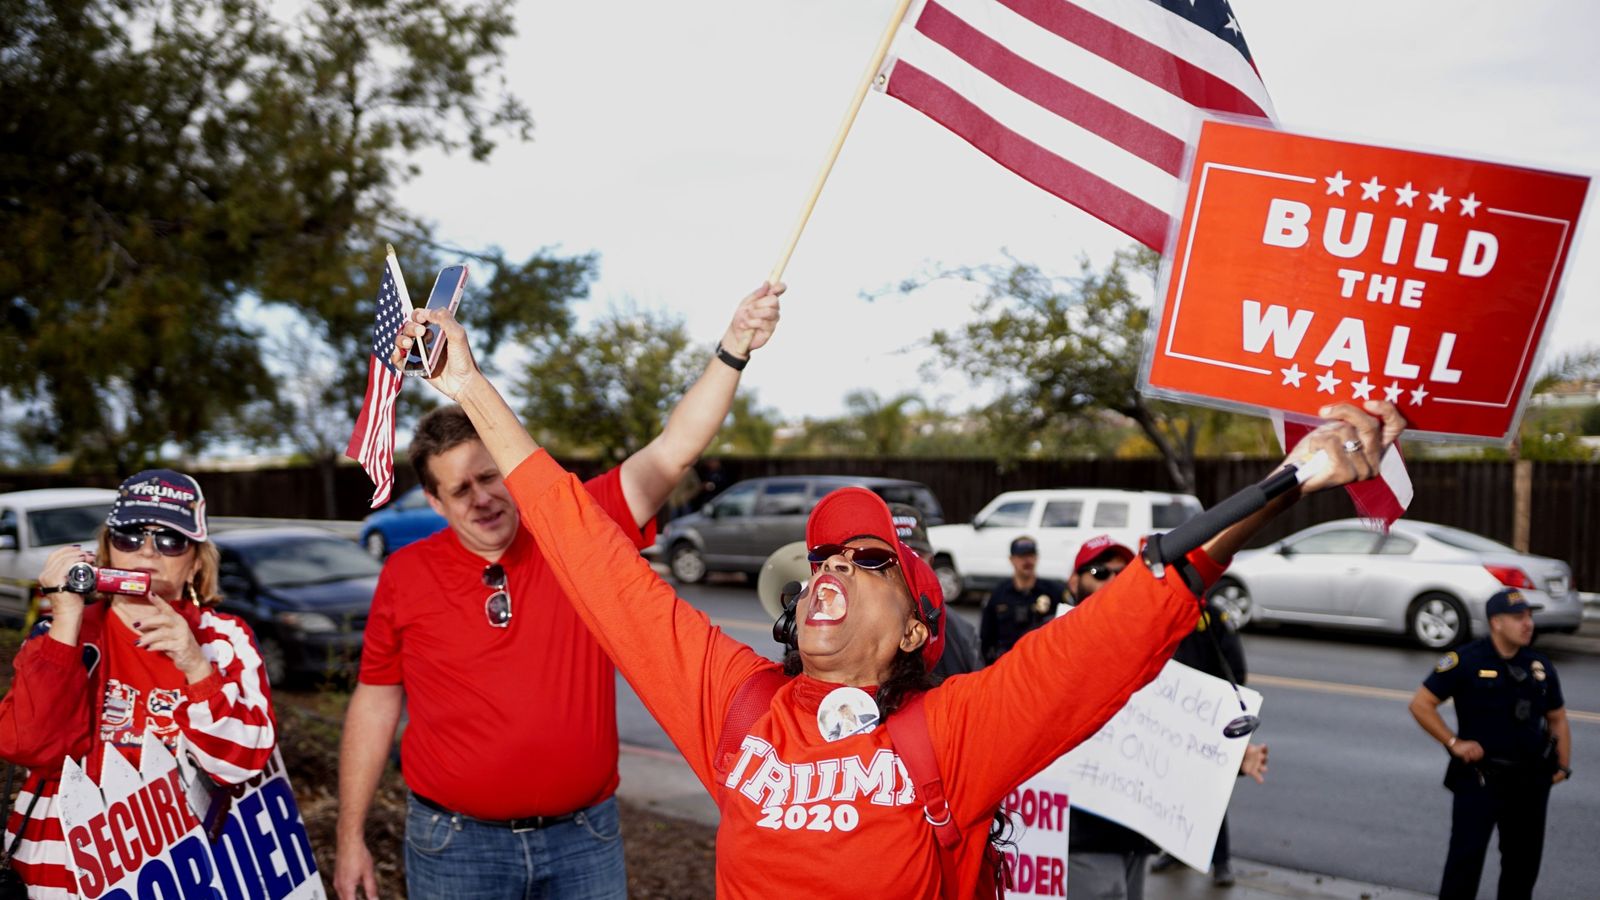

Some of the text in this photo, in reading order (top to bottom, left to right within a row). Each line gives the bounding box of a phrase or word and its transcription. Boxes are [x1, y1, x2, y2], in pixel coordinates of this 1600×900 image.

[1262, 198, 1500, 278] BUILD
[1337, 268, 1427, 309] THE
[1242, 299, 1463, 384] WALL
[132, 484, 195, 501] TRUMP
[1181, 687, 1223, 727] del
[1120, 733, 1170, 779] ONU
[757, 804, 859, 832] 2020
[1002, 788, 1069, 832] PORT
[68, 767, 201, 899] SECURE
[99, 776, 318, 900] RDER
